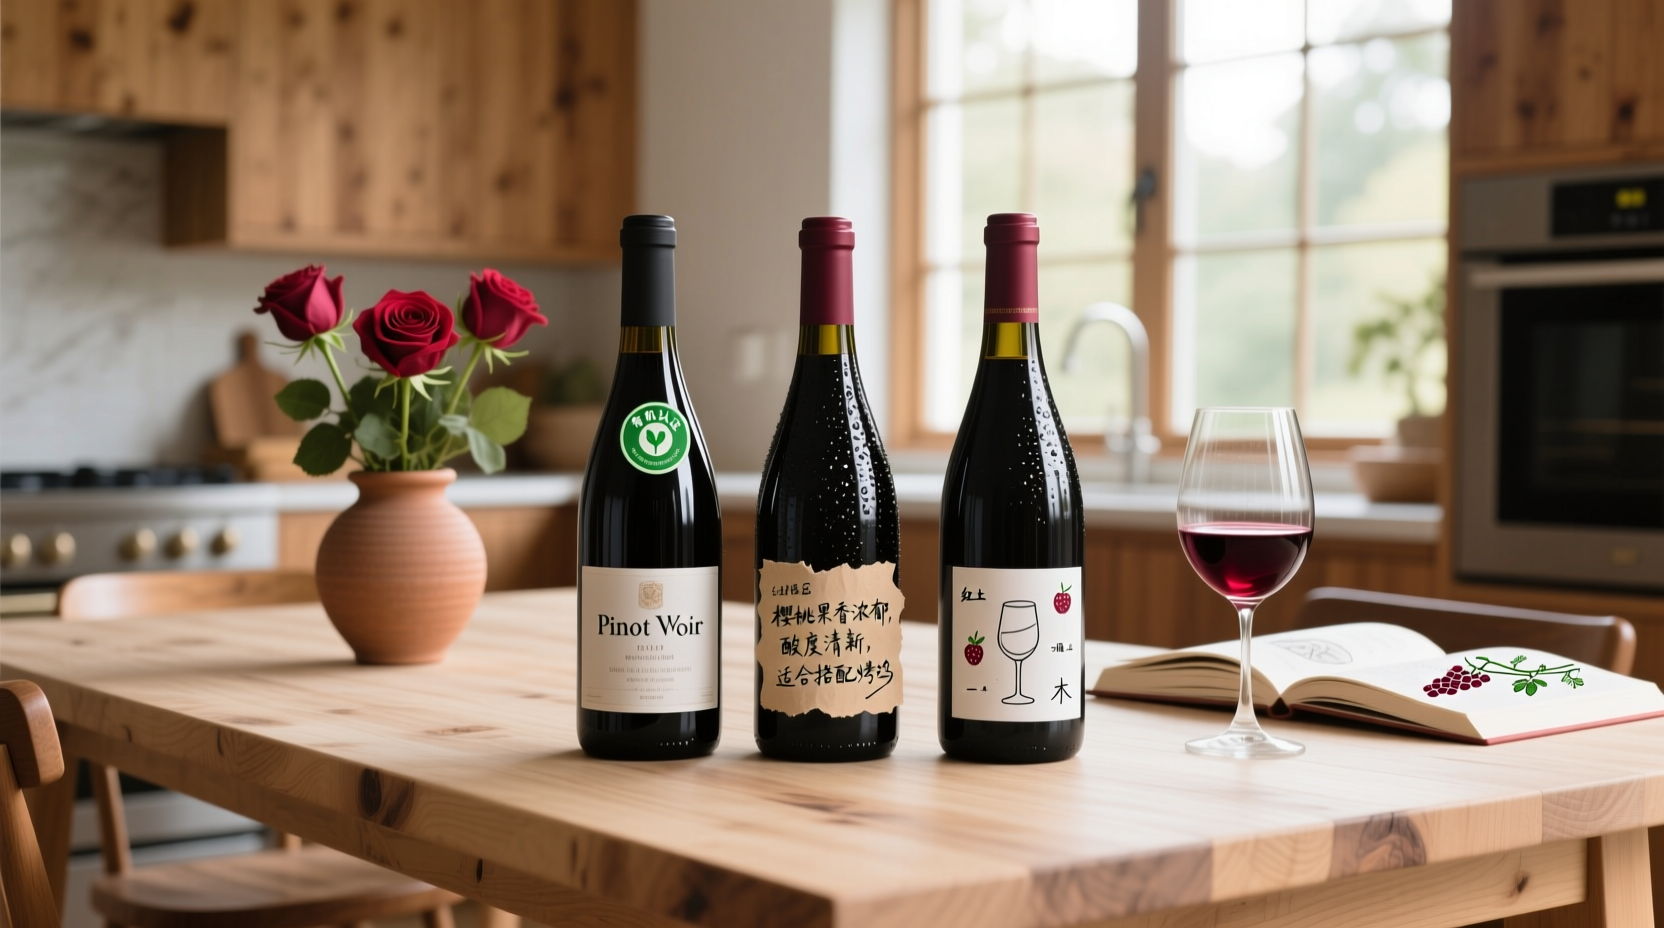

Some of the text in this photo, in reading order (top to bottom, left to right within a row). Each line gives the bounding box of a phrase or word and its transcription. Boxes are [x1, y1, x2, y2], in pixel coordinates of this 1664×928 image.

[598, 614, 704, 636] Pinot Woir
[1050, 677, 1072, 704] 木
